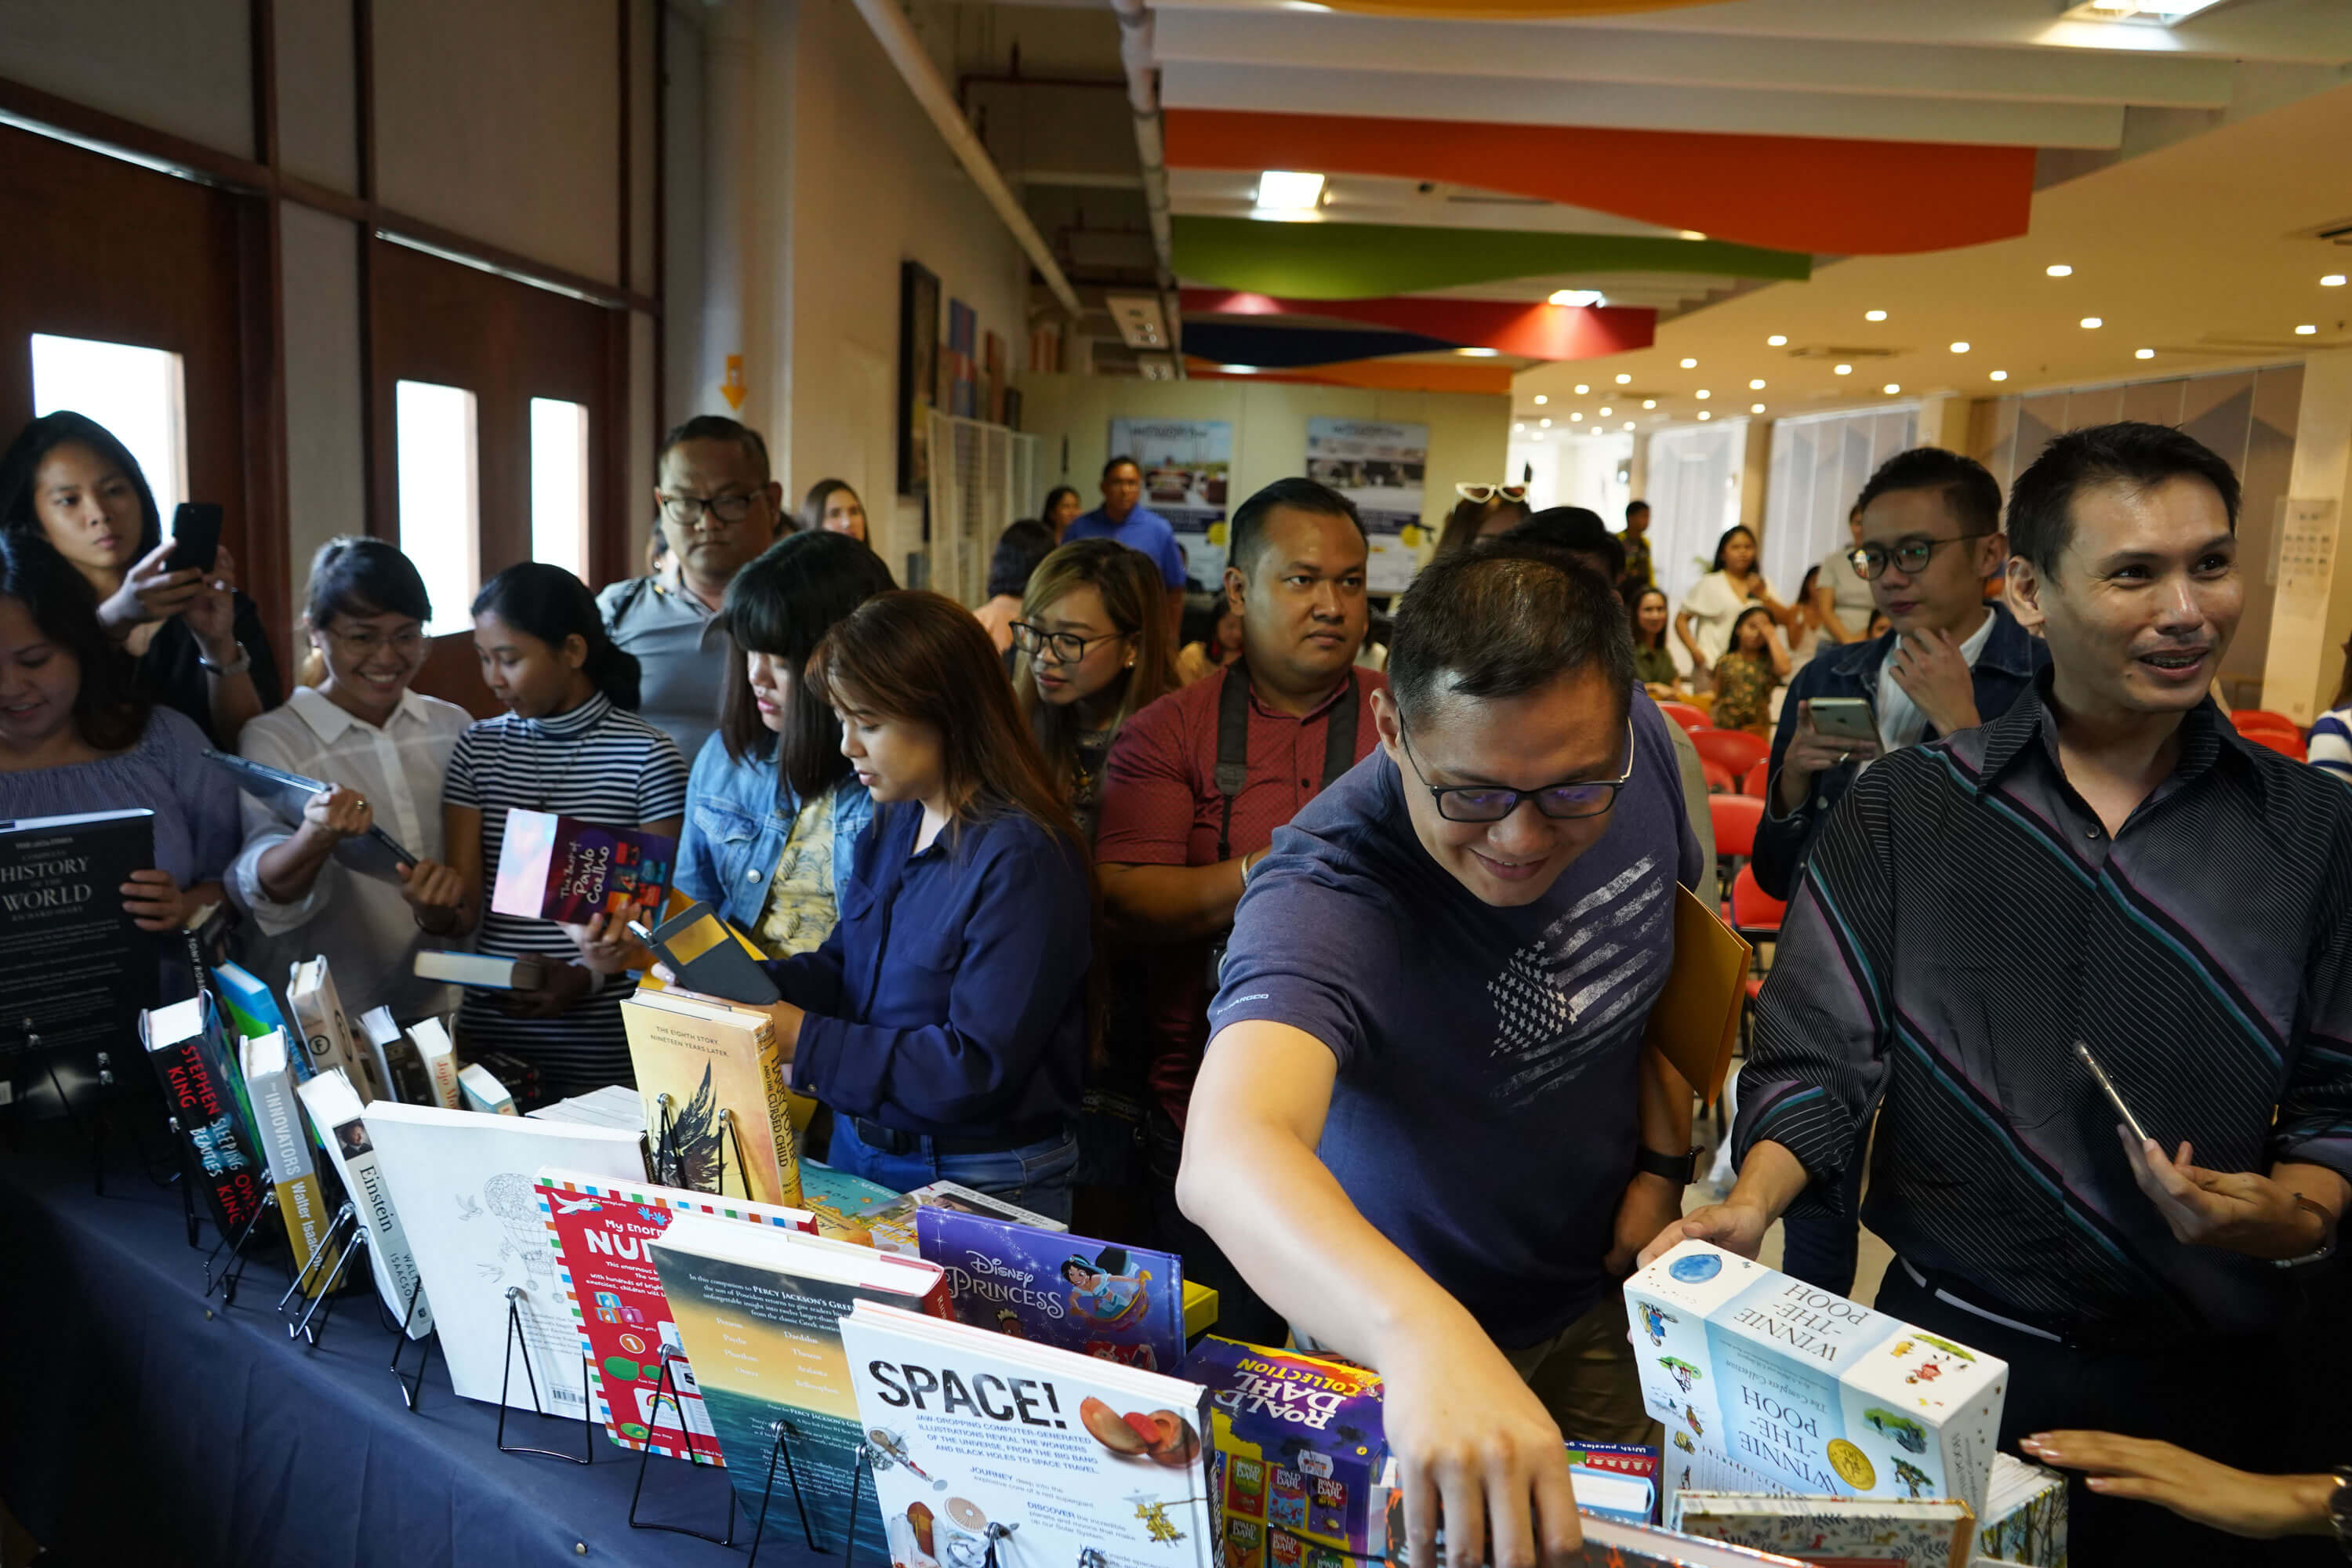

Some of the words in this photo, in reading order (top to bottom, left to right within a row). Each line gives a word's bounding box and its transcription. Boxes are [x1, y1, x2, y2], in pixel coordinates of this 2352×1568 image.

[1, 856, 89, 883] HISTORY
[572, 848, 596, 896] Paulo
[587, 845, 610, 904] Coelho
[2, 883, 93, 912] WORLD
[187, 938, 201, 964] TONY
[650, 1034, 683, 1047] NINETEEN
[683, 1040, 706, 1052] YEARS
[655, 1025, 669, 1034] THE
[670, 1028, 695, 1040] EIGHTH
[167, 1065, 197, 1109] KING
[181, 1044, 221, 1116] STEPHEN
[435, 1061, 450, 1087] Jojo
[264, 1092, 302, 1177] INNOVATORS
[768, 1092, 782, 1133] CURSED
[775, 1134, 789, 1168] CHILD
[189, 1126, 224, 1178] BEAUTIES
[210, 1116, 245, 1171] SLEEPING
[290, 1181, 311, 1222] Walter
[359, 1164, 394, 1234] Einstein
[604, 1218, 624, 1233] My
[604, 1275, 635, 1287] hundreds
[619, 1286, 646, 1294] children
[710, 1279, 744, 1290] companion
[752, 1286, 779, 1298] PERCY
[781, 1291, 827, 1307] JACKSON'S
[943, 1265, 1065, 1319] PRINCESS
[702, 1294, 742, 1305] unforgettable
[735, 1290, 764, 1301] Poseidon
[809, 1306, 833, 1316] readers
[1782, 1283, 1871, 1327] POOH
[750, 1308, 767, 1318] from
[798, 1319, 818, 1329] Greek
[626, 1337, 639, 1351] 1
[782, 1330, 819, 1345] Daedalus
[1733, 1307, 1838, 1364] WINNIE
[1236, 1358, 1361, 1398] COLLECTION
[1725, 1359, 1766, 1387] Collection
[868, 1359, 1068, 1430] SPACE!
[1232, 1370, 1348, 1414] DAHL
[1767, 1381, 1809, 1405] Complete
[789, 1408, 811, 1417] PERCY
[811, 1413, 846, 1426] JACKSON'S
[1214, 1389, 1335, 1431] ROALD
[1741, 1385, 1820, 1439] POOH
[1809, 1399, 1826, 1413] The
[916, 1414, 982, 1430] JAW-DROPPING
[983, 1423, 1091, 1444] COMPUTER-GENERATED
[917, 1424, 984, 1439] ILLUSTRATIONS
[985, 1432, 1019, 1444] REVEAL
[1022, 1438, 1039, 1447] THE
[1040, 1441, 1087, 1454] WONDERS
[927, 1433, 939, 1443] OF
[941, 1436, 959, 1445] THE
[959, 1438, 1006, 1452] UNIVERSE,
[1006, 1444, 1034, 1455] FROM
[1034, 1449, 1052, 1458] THE
[1054, 1452, 1071, 1461] BIG
[1072, 1454, 1098, 1465] BANG
[935, 1444, 955, 1454] AND
[956, 1446, 985, 1457] BLACK
[985, 1451, 1018, 1463] HOLES
[1018, 1456, 1032, 1465] TO
[1032, 1458, 1063, 1469] SPACE
[970, 1466, 1014, 1482] JOURNEY
[1236, 1461, 1261, 1475] ROALD
[1236, 1468, 1261, 1483] DAHL
[1276, 1468, 1301, 1481] ROALD
[1740, 1429, 1840, 1496] WINNIE
[1276, 1475, 1301, 1490] DAHL
[1317, 1478, 1343, 1491] ROALD
[1317, 1485, 1342, 1500] DAHL
[1026, 1501, 1076, 1519] DISCOVER
[1232, 1526, 1256, 1541] DAHL
[1233, 1519, 1257, 1533] ROALD
[1272, 1540, 1297, 1555] DAHL
[1273, 1533, 1298, 1546] ROALD
